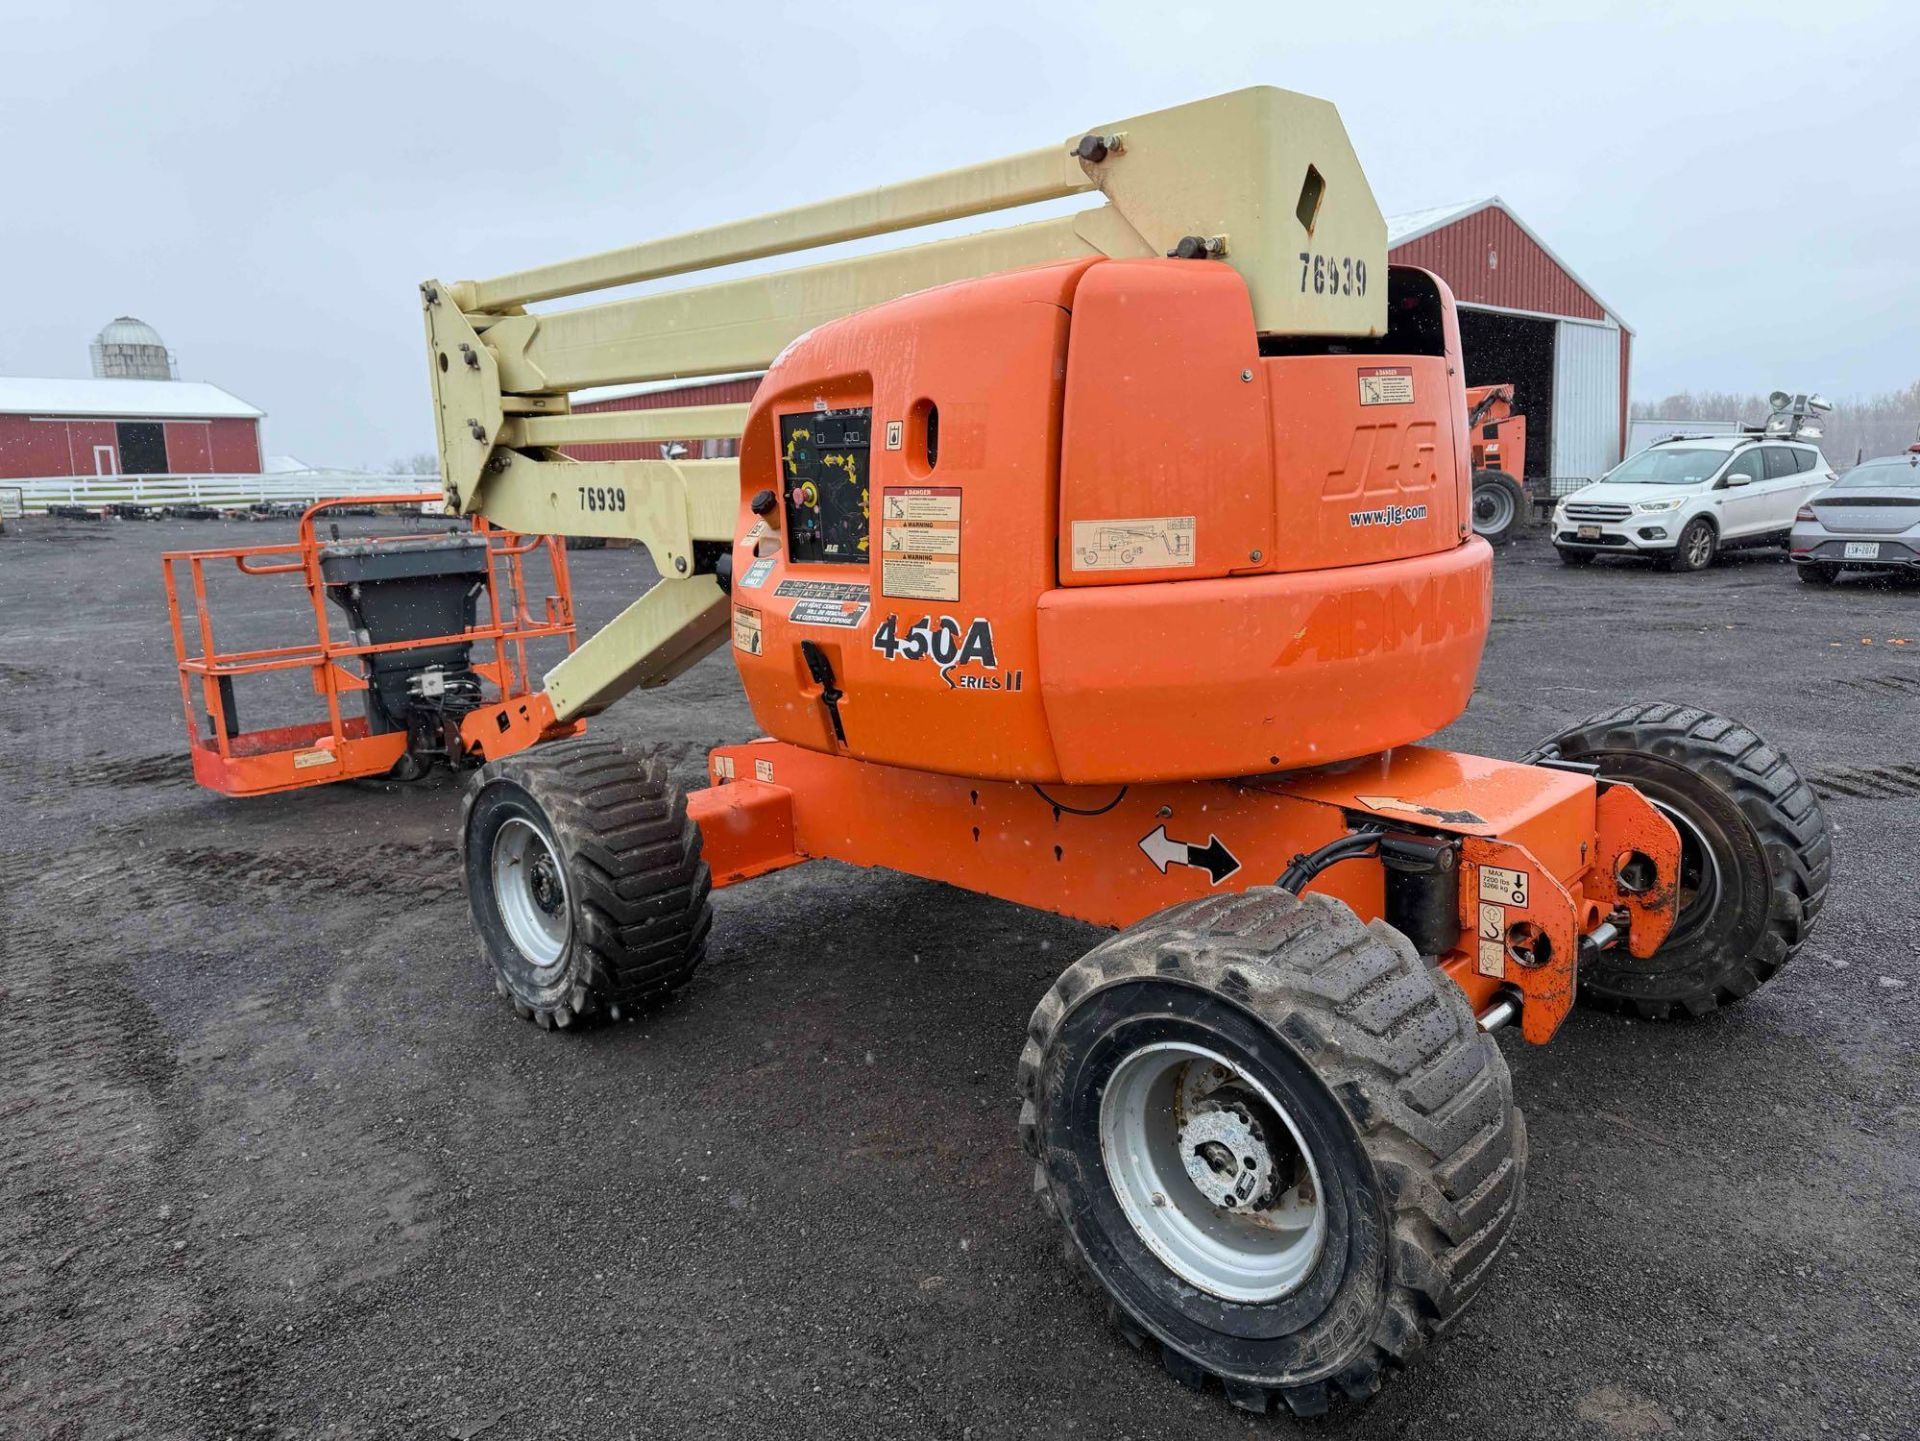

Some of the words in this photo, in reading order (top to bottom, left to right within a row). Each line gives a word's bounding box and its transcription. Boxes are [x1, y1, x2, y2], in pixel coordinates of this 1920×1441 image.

[1299, 252, 1367, 297] 76939
[1320, 421, 1437, 502] JLG
[578, 486, 626, 512] 76939
[907, 521, 934, 529] WARNING
[1349, 505, 1428, 527] www.jlg.com
[824, 544, 839, 553] JLG
[872, 613, 998, 670] 450A
[940, 665, 1001, 690] SERIES
[1488, 869, 1504, 877] MAX
